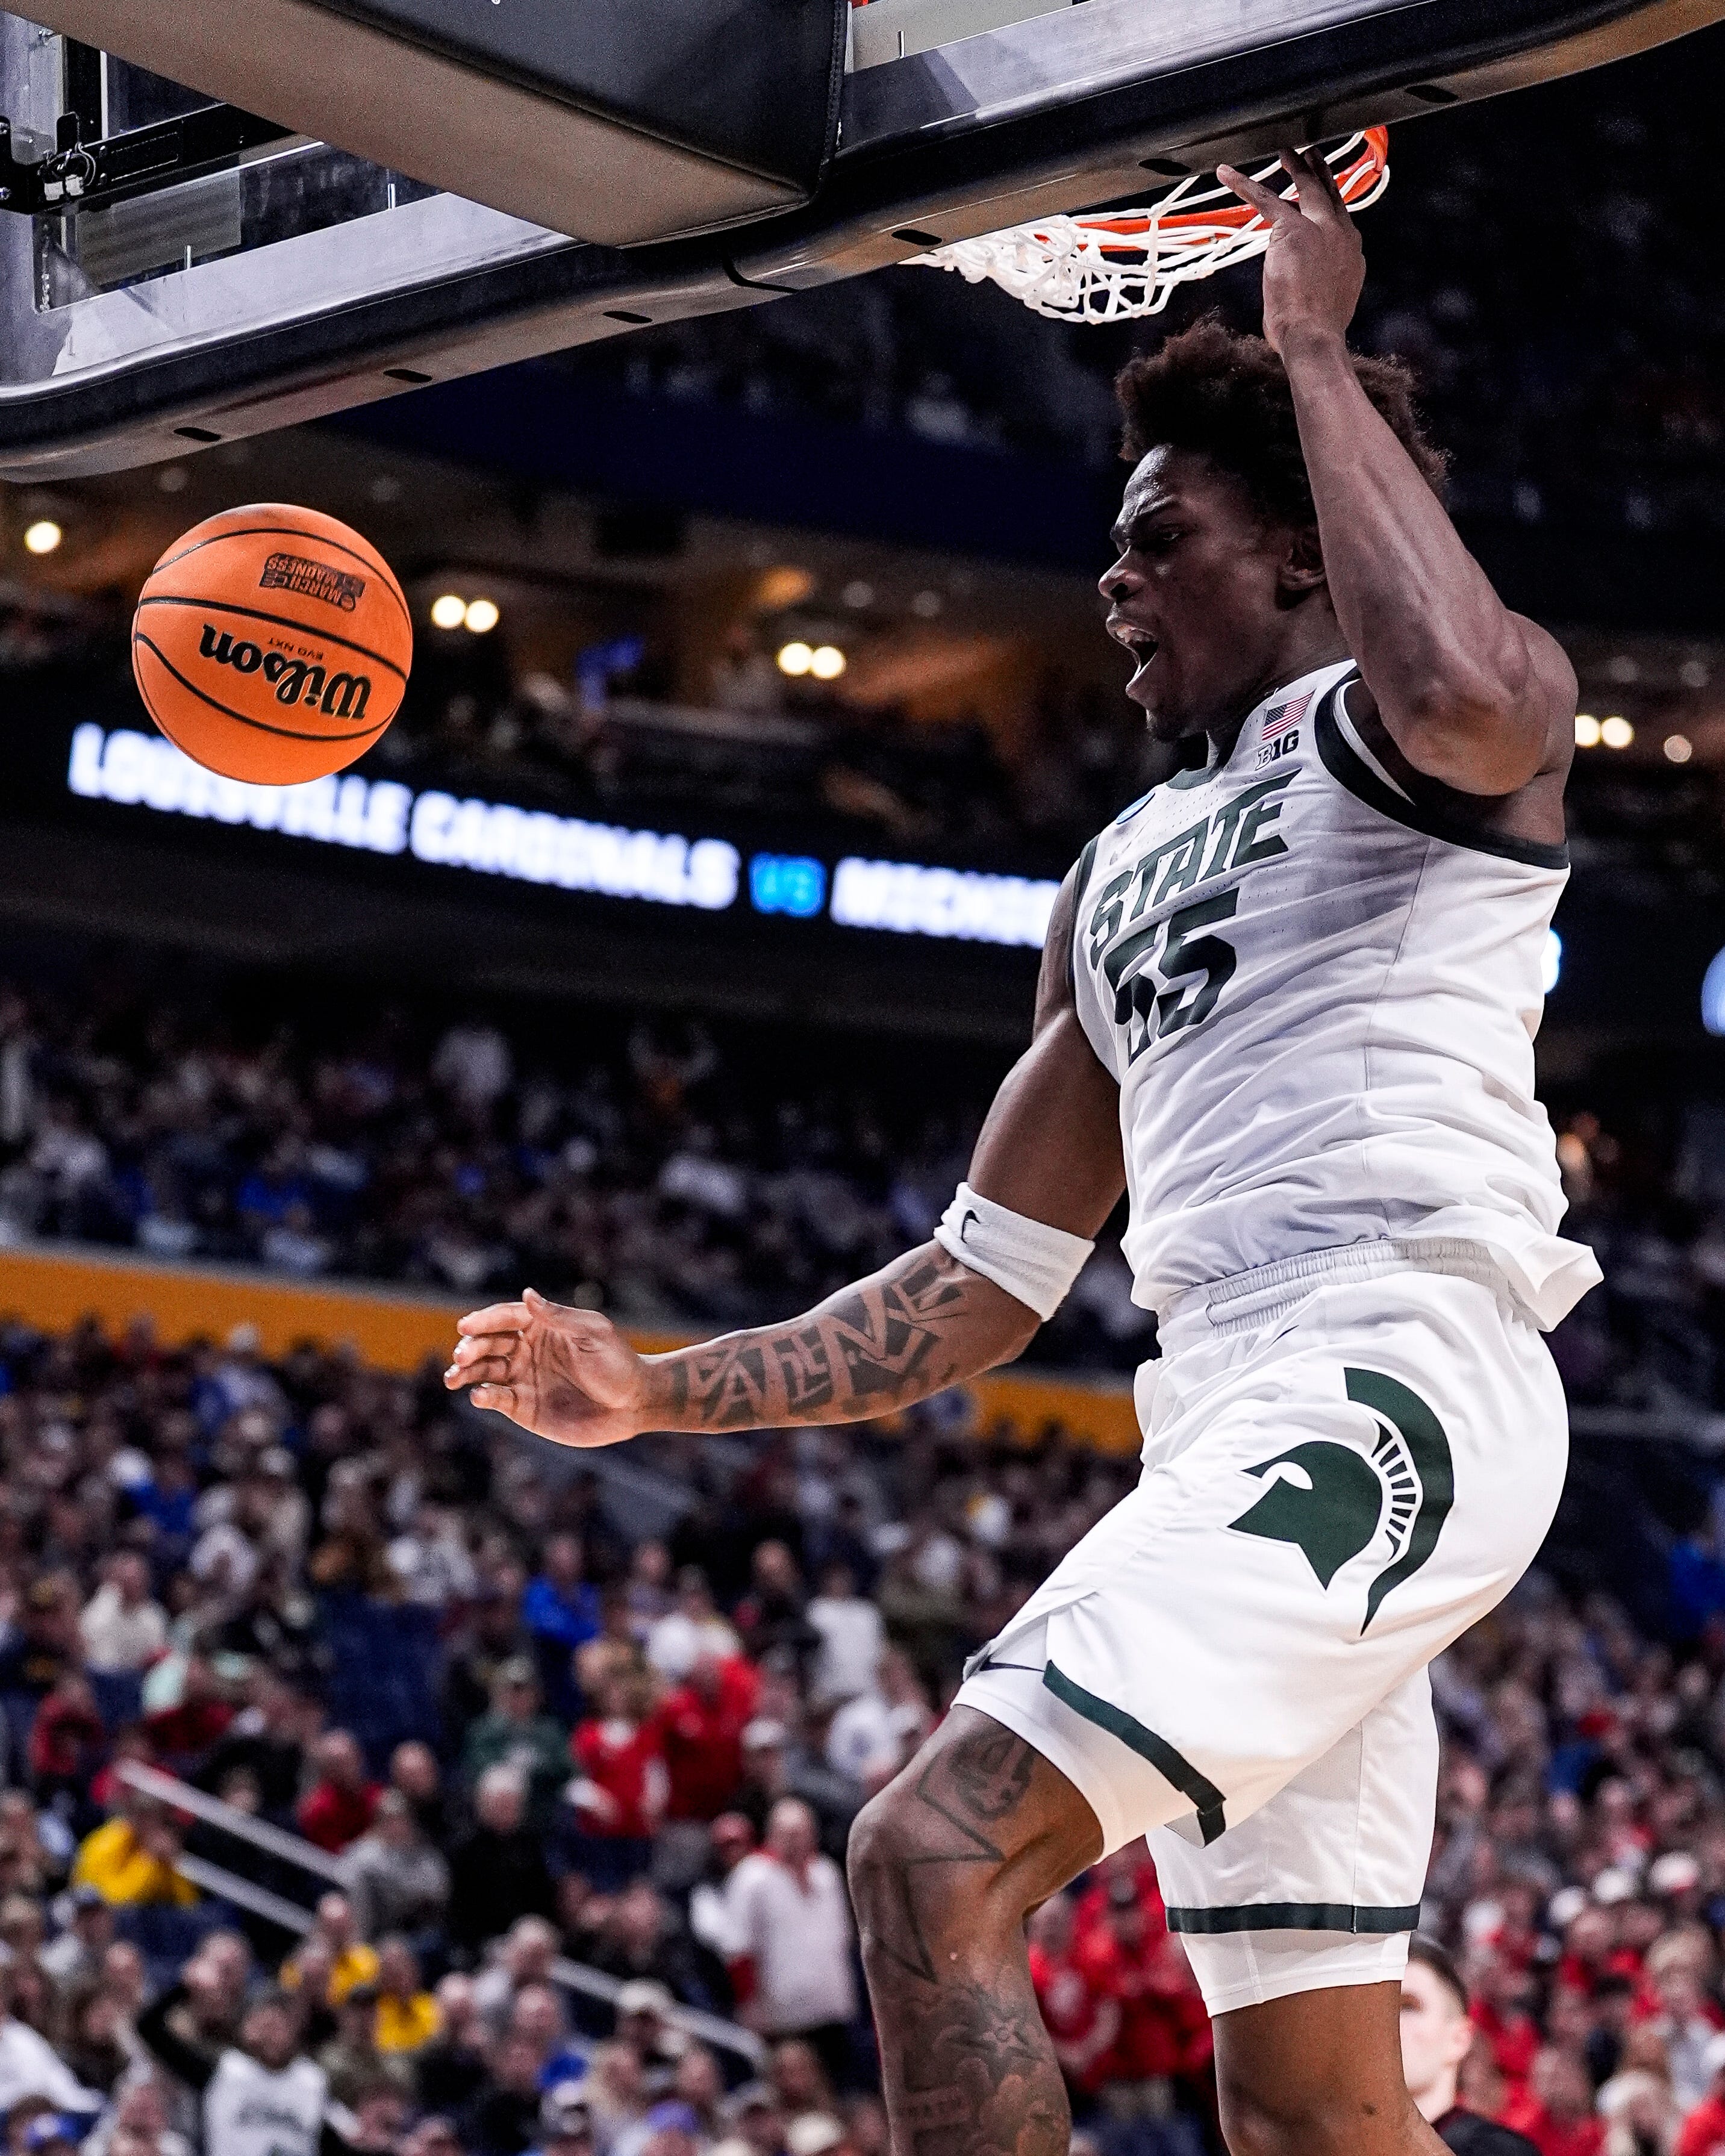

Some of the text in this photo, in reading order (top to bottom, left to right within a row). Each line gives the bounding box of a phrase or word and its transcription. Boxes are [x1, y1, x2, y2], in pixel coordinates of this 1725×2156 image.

[267, 556, 338, 587] MADNESS
[289, 573, 343, 604] MARCH
[199, 623, 371, 720] Wilson
[267, 637, 324, 661] EVO NXT
[412, 791, 737, 907] CARDINALS
[1089, 768, 1301, 970] STATE
[1105, 886, 1240, 1066] 55
